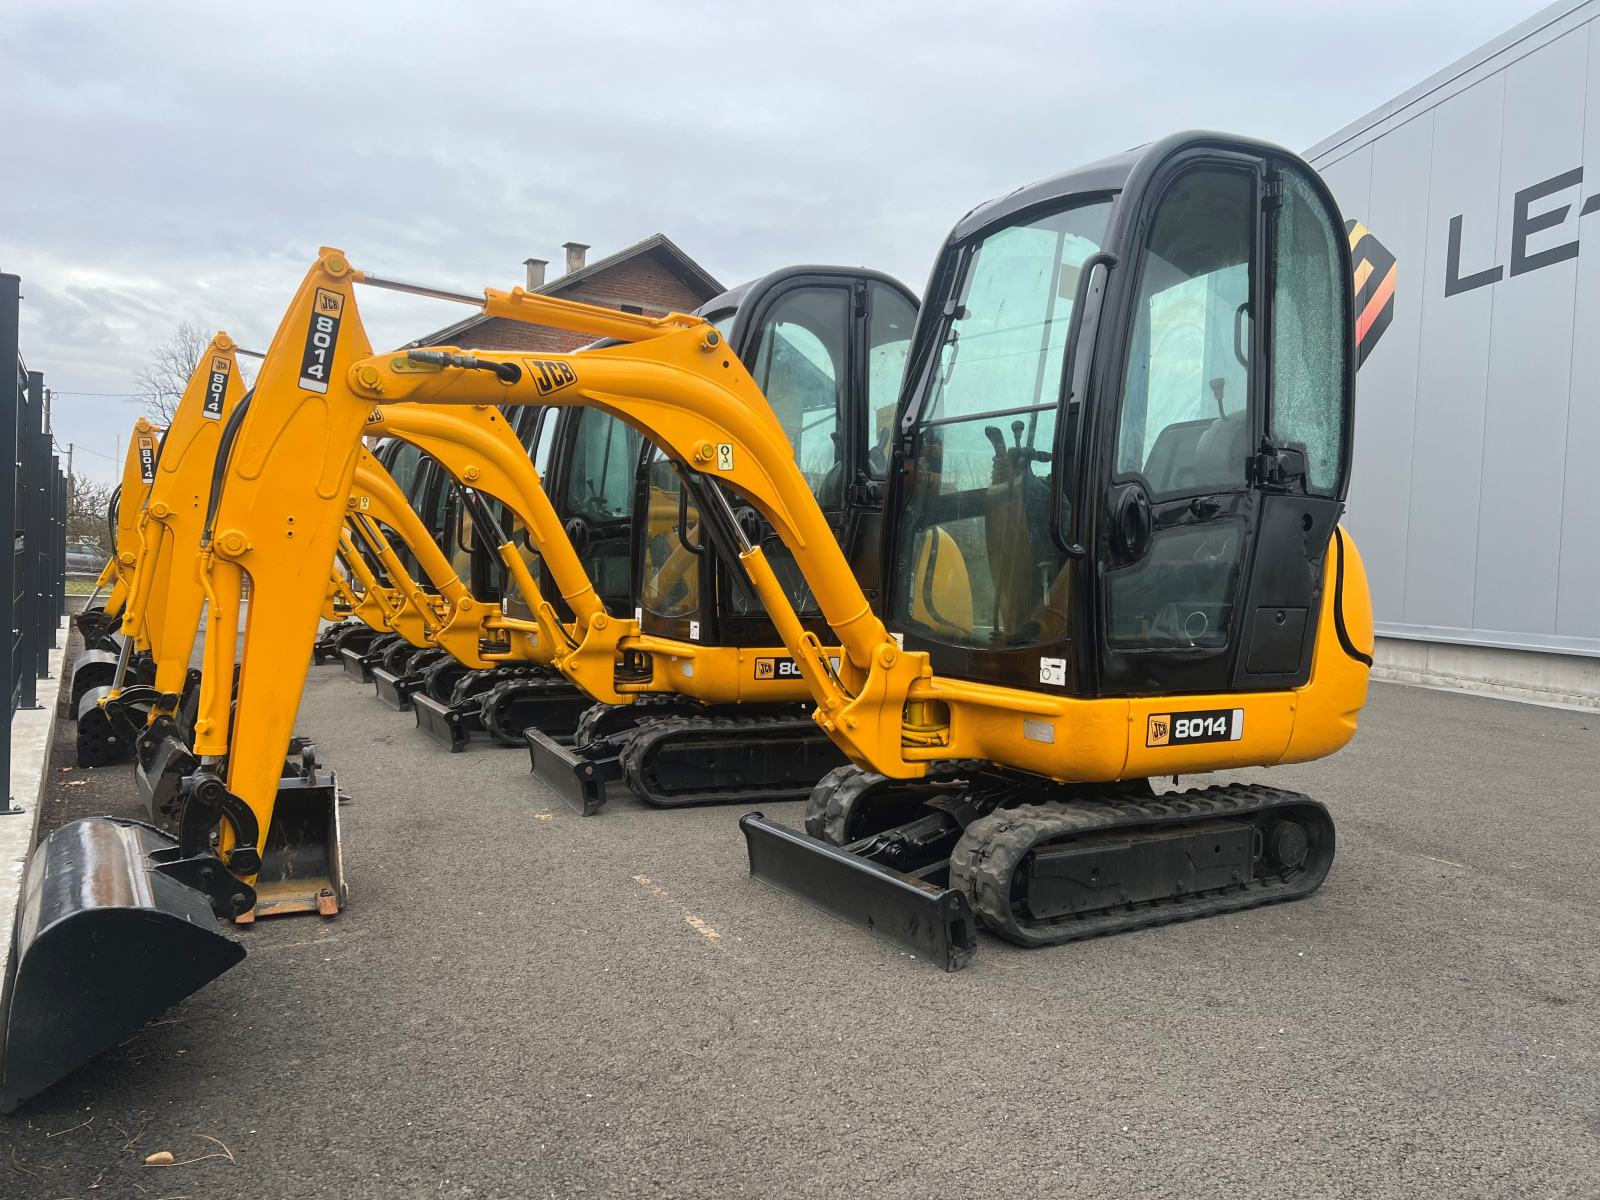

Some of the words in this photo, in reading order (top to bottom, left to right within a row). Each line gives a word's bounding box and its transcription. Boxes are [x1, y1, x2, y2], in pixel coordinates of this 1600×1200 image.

[321, 296, 338, 310] JCB
[307, 317, 333, 379] 8014
[532, 360, 574, 391] JCB
[208, 373, 224, 411] 8014
[142, 449, 153, 478] 8014
[1153, 722, 1168, 739] JCB
[1175, 716, 1227, 738] 8014
